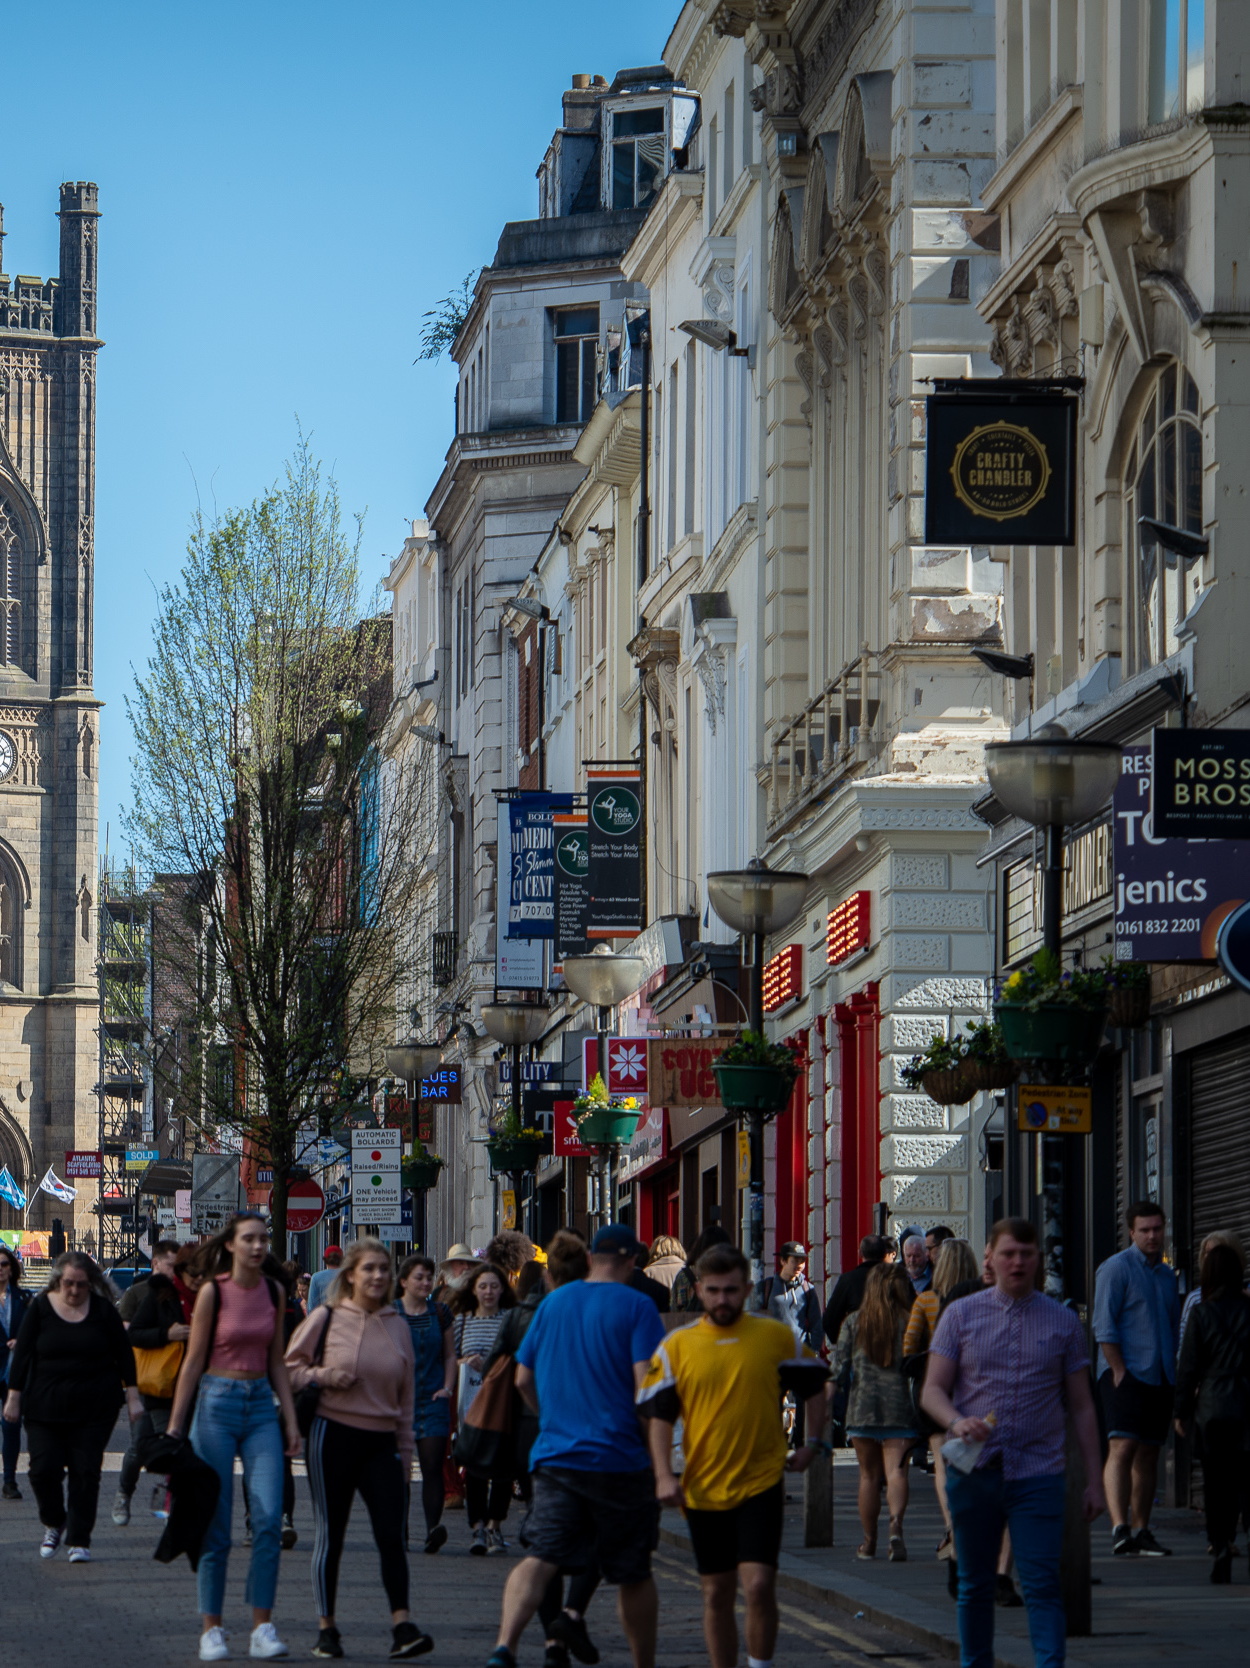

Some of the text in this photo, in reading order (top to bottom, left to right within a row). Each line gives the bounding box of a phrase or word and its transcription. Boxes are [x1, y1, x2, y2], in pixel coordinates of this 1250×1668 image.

[987, 432, 1017, 441] COCKTAILS
[976, 452, 1025, 469] CRAFTY
[968, 469, 1033, 487] CHANDLER
[1174, 757, 1250, 780] MOSS
[1174, 783, 1250, 806] BROS
[591, 843, 639, 851] Stretch Your Body
[1116, 871, 1207, 915] jenics
[1116, 918, 1200, 935] 0161 832 2201
[502, 1063, 550, 1081] ULITY
[1068, 1089, 1089, 1099] Zone
[130, 1151, 153, 1160] SOLD
[354, 1163, 399, 1171] Raised/Rising
[195, 1203, 235, 1211] Pedestrian
